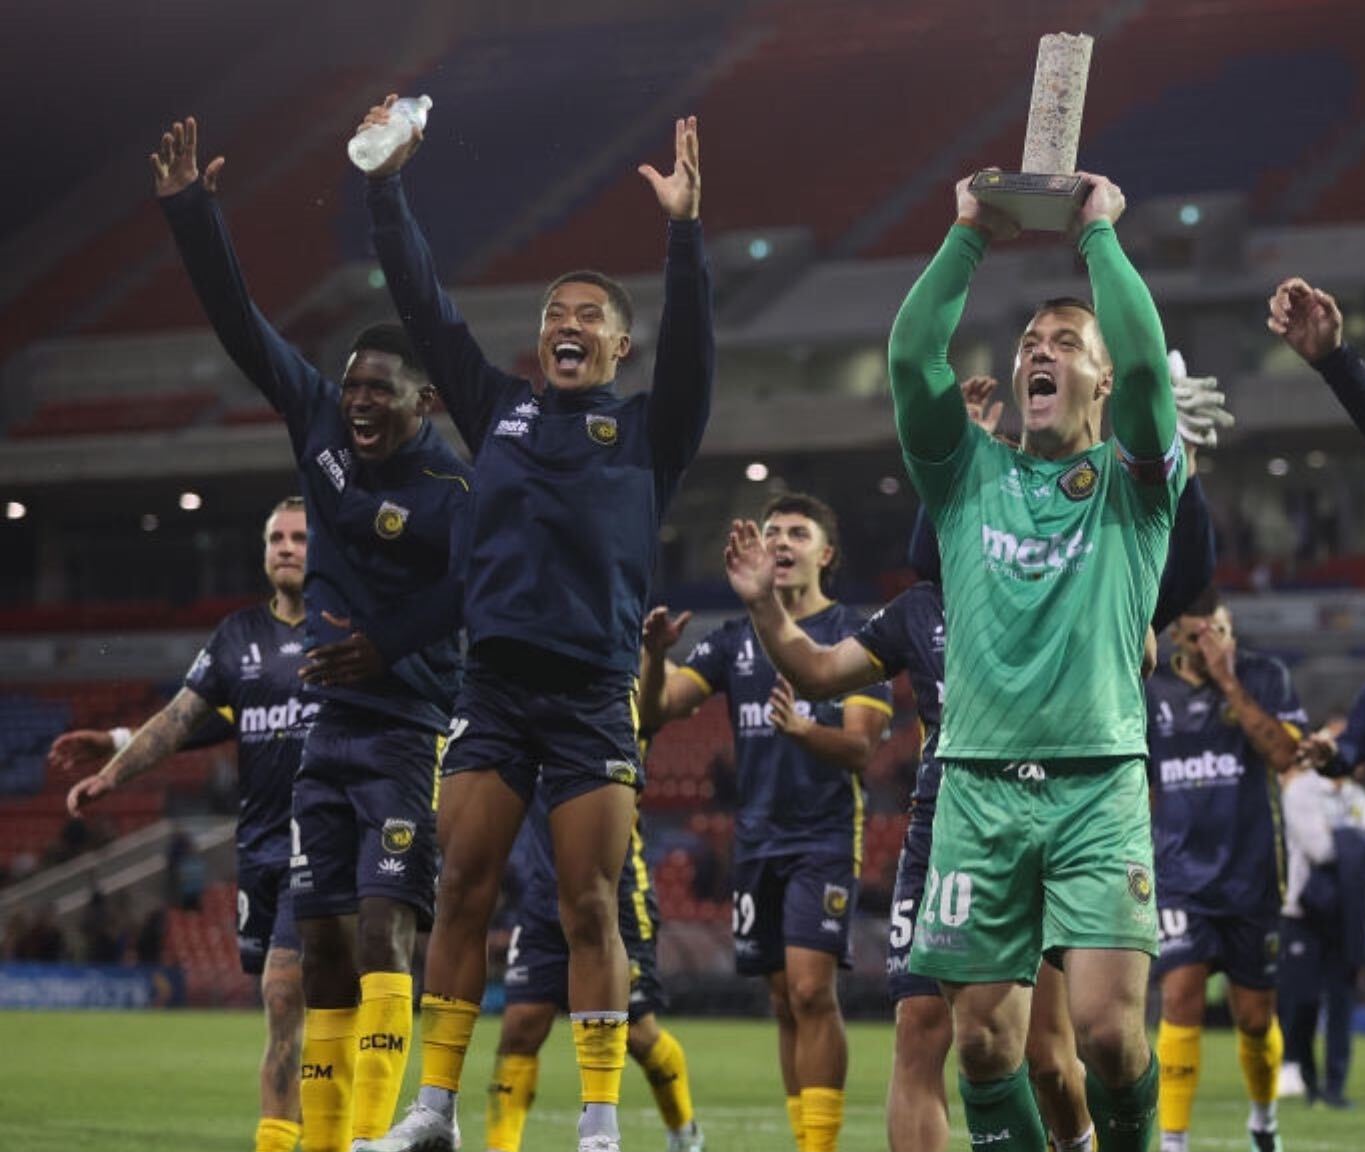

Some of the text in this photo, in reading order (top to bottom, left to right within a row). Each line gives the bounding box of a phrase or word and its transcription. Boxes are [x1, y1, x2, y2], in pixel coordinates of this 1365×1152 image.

[981, 523, 1094, 569] mate.
[1161, 749, 1244, 783] mate.
[890, 897, 914, 948] 5
[359, 1032, 405, 1052] CCM
